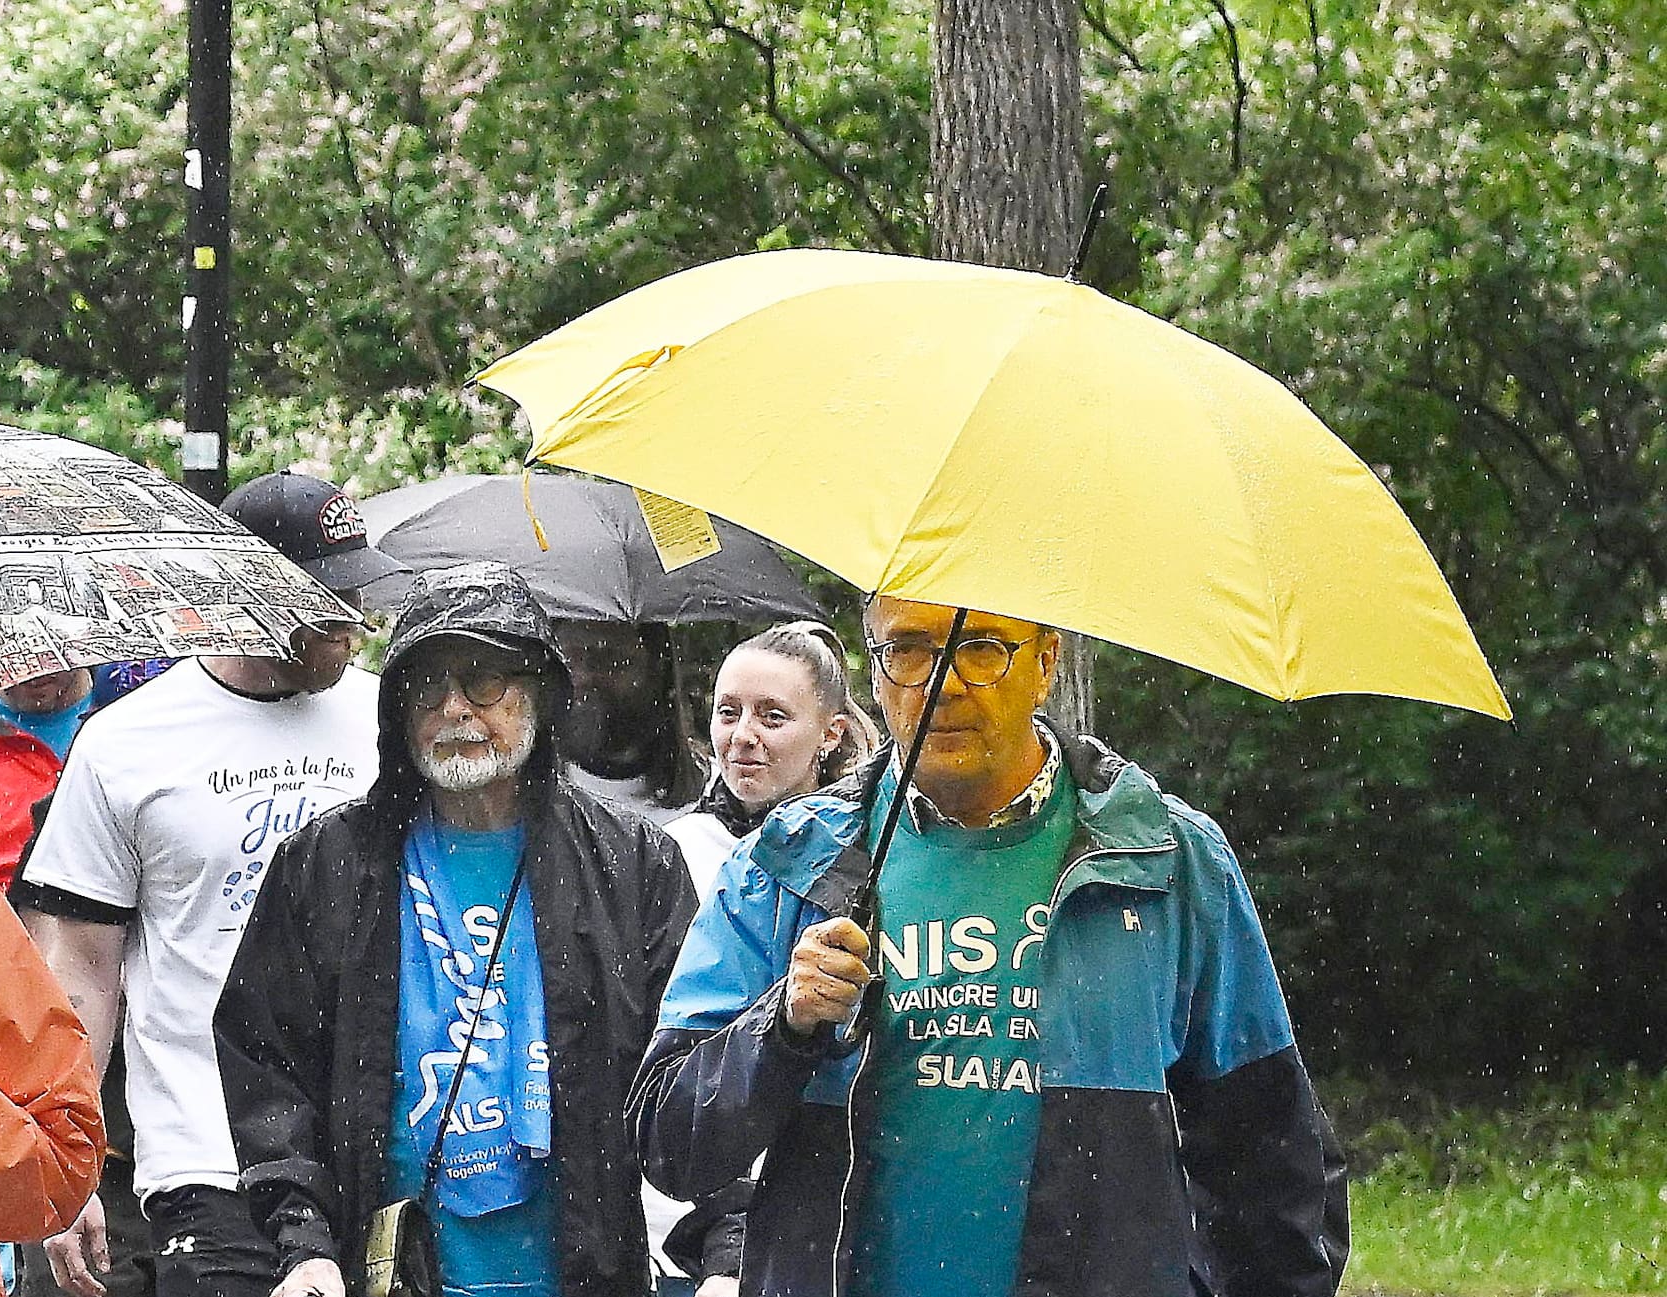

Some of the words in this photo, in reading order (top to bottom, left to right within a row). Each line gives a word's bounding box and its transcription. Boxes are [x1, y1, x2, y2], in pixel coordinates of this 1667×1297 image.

[208, 768, 244, 794] Un
[249, 764, 278, 788] pas
[284, 759, 297, 776] à
[302, 756, 321, 775] la
[323, 757, 355, 781] fois
[273, 781, 305, 796] pour
[240, 797, 317, 854] Juli
[878, 915, 999, 981] NIS
[888, 983, 998, 1013] VAINCRE
[908, 1018, 943, 1041] LA
[943, 1014, 994, 1037] SLA
[917, 1054, 990, 1089] SLA
